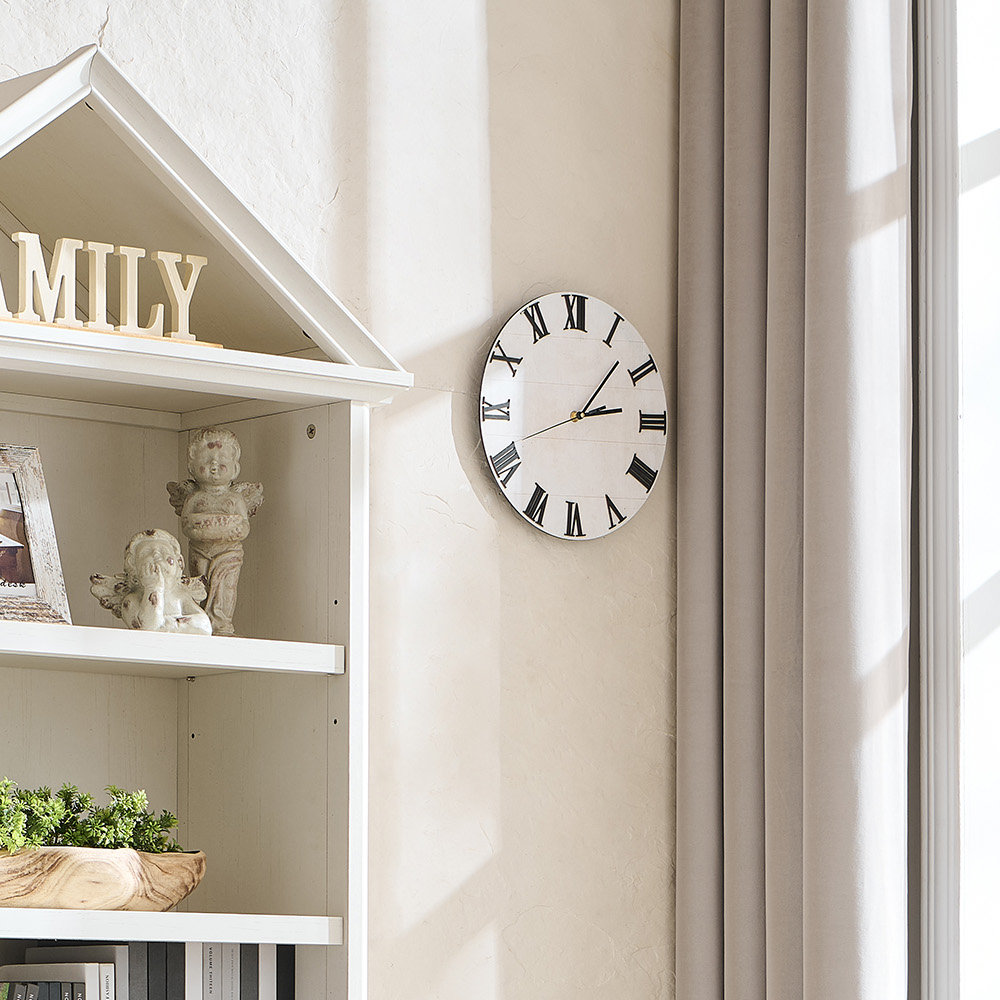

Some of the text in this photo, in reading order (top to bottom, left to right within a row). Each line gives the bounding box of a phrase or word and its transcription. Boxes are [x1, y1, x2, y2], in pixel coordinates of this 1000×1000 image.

[520, 301, 550, 344] XI
[561, 295, 588, 333] XII
[490, 340, 523, 377] X
[628, 354, 657, 386] II
[482, 396, 510, 421] IX
[639, 410, 666, 435] III
[523, 482, 549, 527] VII
[564, 501, 586, 537] VI
[605, 494, 627, 529] V
